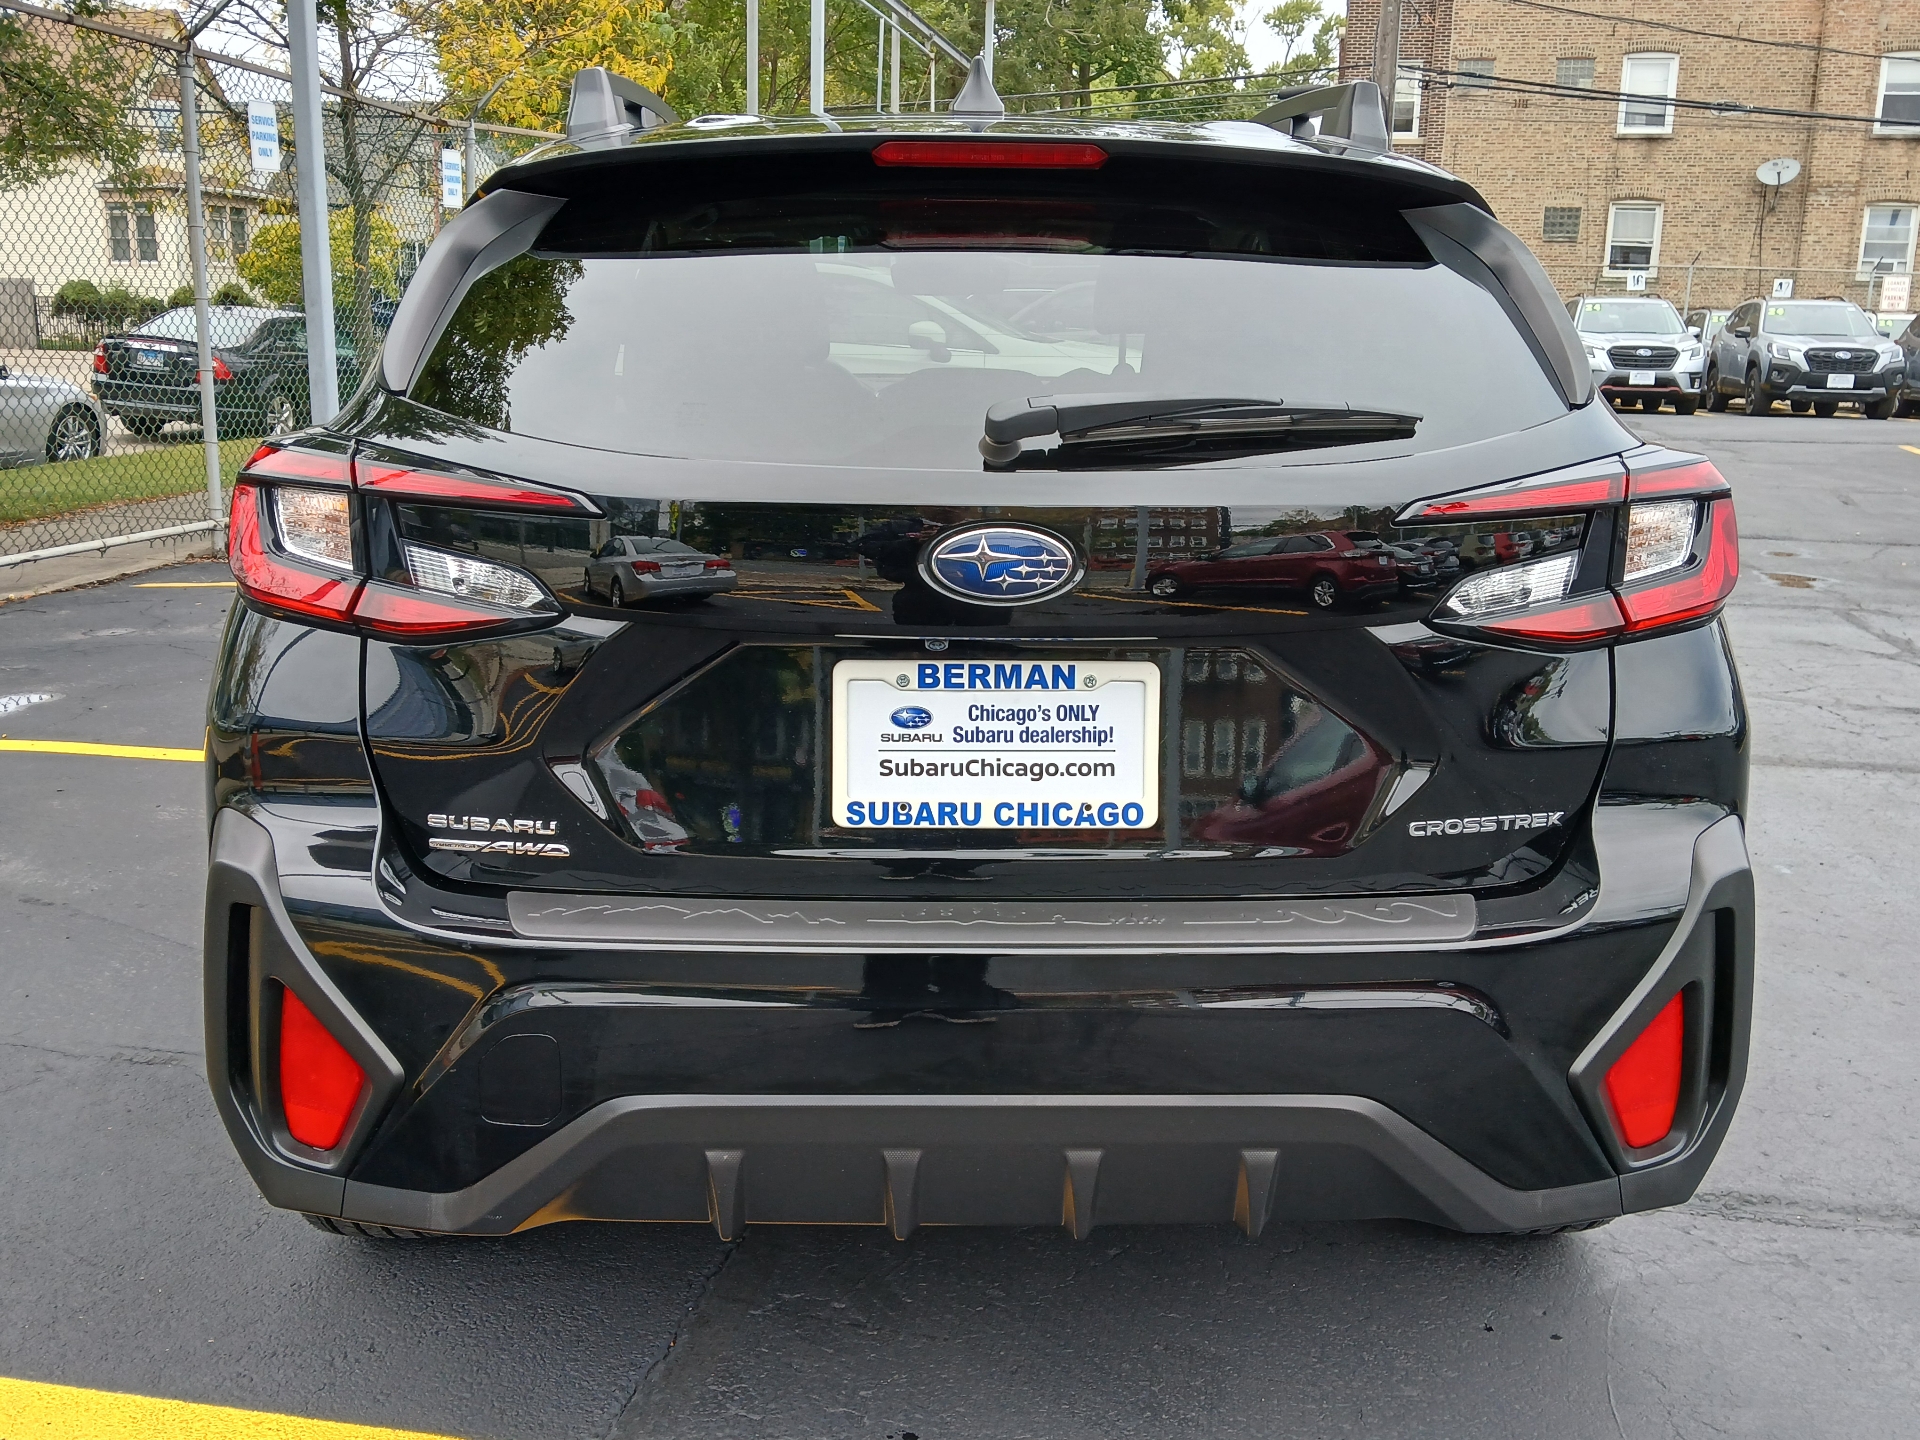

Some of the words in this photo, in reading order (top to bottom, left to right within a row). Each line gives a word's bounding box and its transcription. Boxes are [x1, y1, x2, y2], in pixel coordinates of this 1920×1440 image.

[251, 115, 274, 127] SERVICE
[252, 131, 276, 142] PARKING
[258, 147, 273, 157] ONLY
[444, 162, 460, 171] SERVICE
[917, 663, 1076, 690] BERMAN
[967, 704, 1051, 725] Chicago's
[1056, 705, 1099, 721] ONLY
[880, 733, 942, 743] SUBARU
[952, 726, 1013, 744] Subaru
[1019, 726, 1114, 746] dealership!
[879, 758, 1115, 781] SubaruChicago.com
[427, 813, 557, 835] SUBARU
[846, 801, 982, 826] SUBARU
[994, 802, 1144, 827] CHICAGO
[1408, 811, 1564, 837] CROSSTREK
[480, 841, 570, 857] AWD
